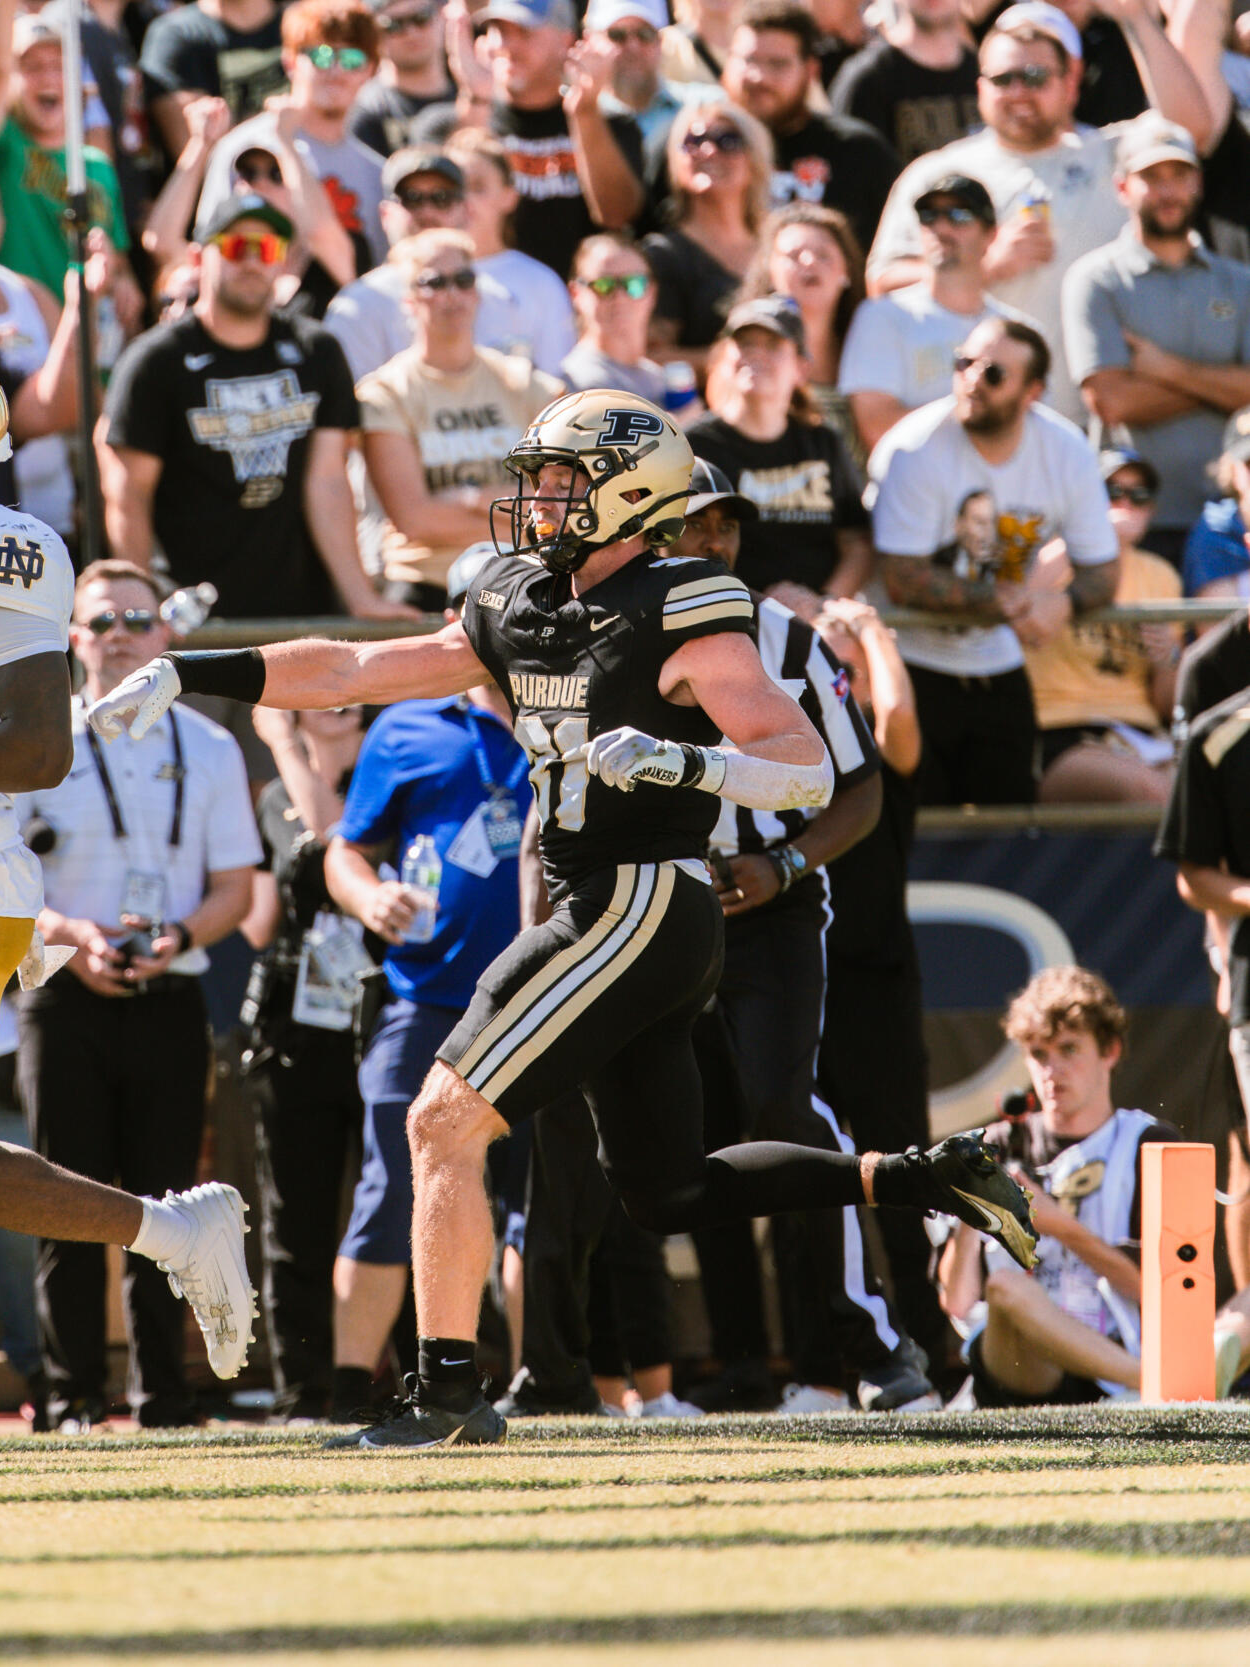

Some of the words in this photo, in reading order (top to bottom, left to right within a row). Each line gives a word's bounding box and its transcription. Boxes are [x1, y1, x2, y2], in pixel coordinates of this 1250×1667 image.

[435, 404, 501, 433] ONE
[596, 408, 664, 447] P
[541, 626, 555, 638] P
[508, 671, 591, 709] PURDUE
